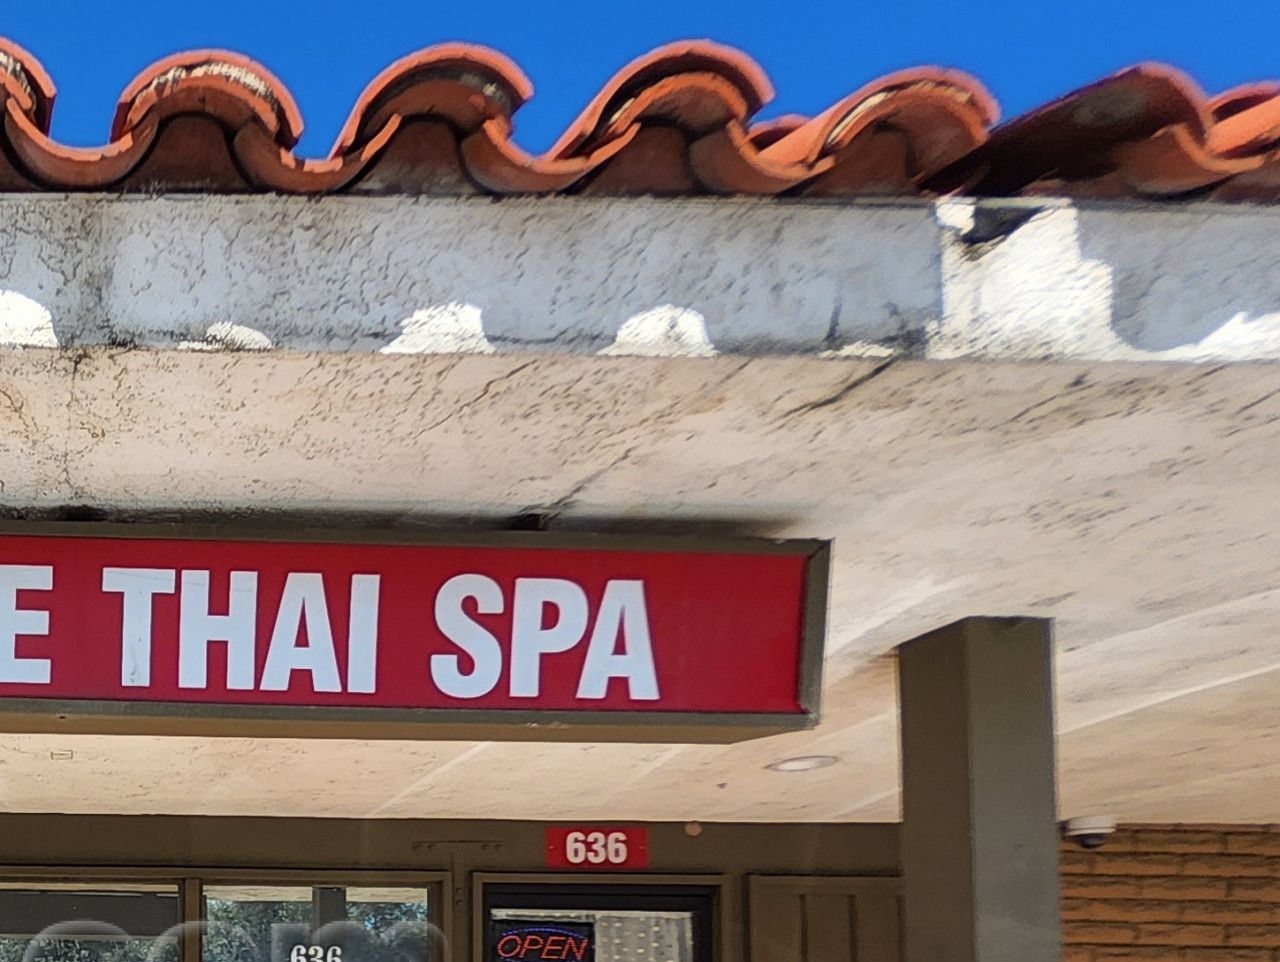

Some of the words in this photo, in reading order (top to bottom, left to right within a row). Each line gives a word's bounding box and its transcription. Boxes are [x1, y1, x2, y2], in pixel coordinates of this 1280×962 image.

[102, 567, 381, 694] THAI
[430, 573, 660, 700] SPA
[565, 831, 628, 864] 636
[496, 935, 589, 962] OPEN
